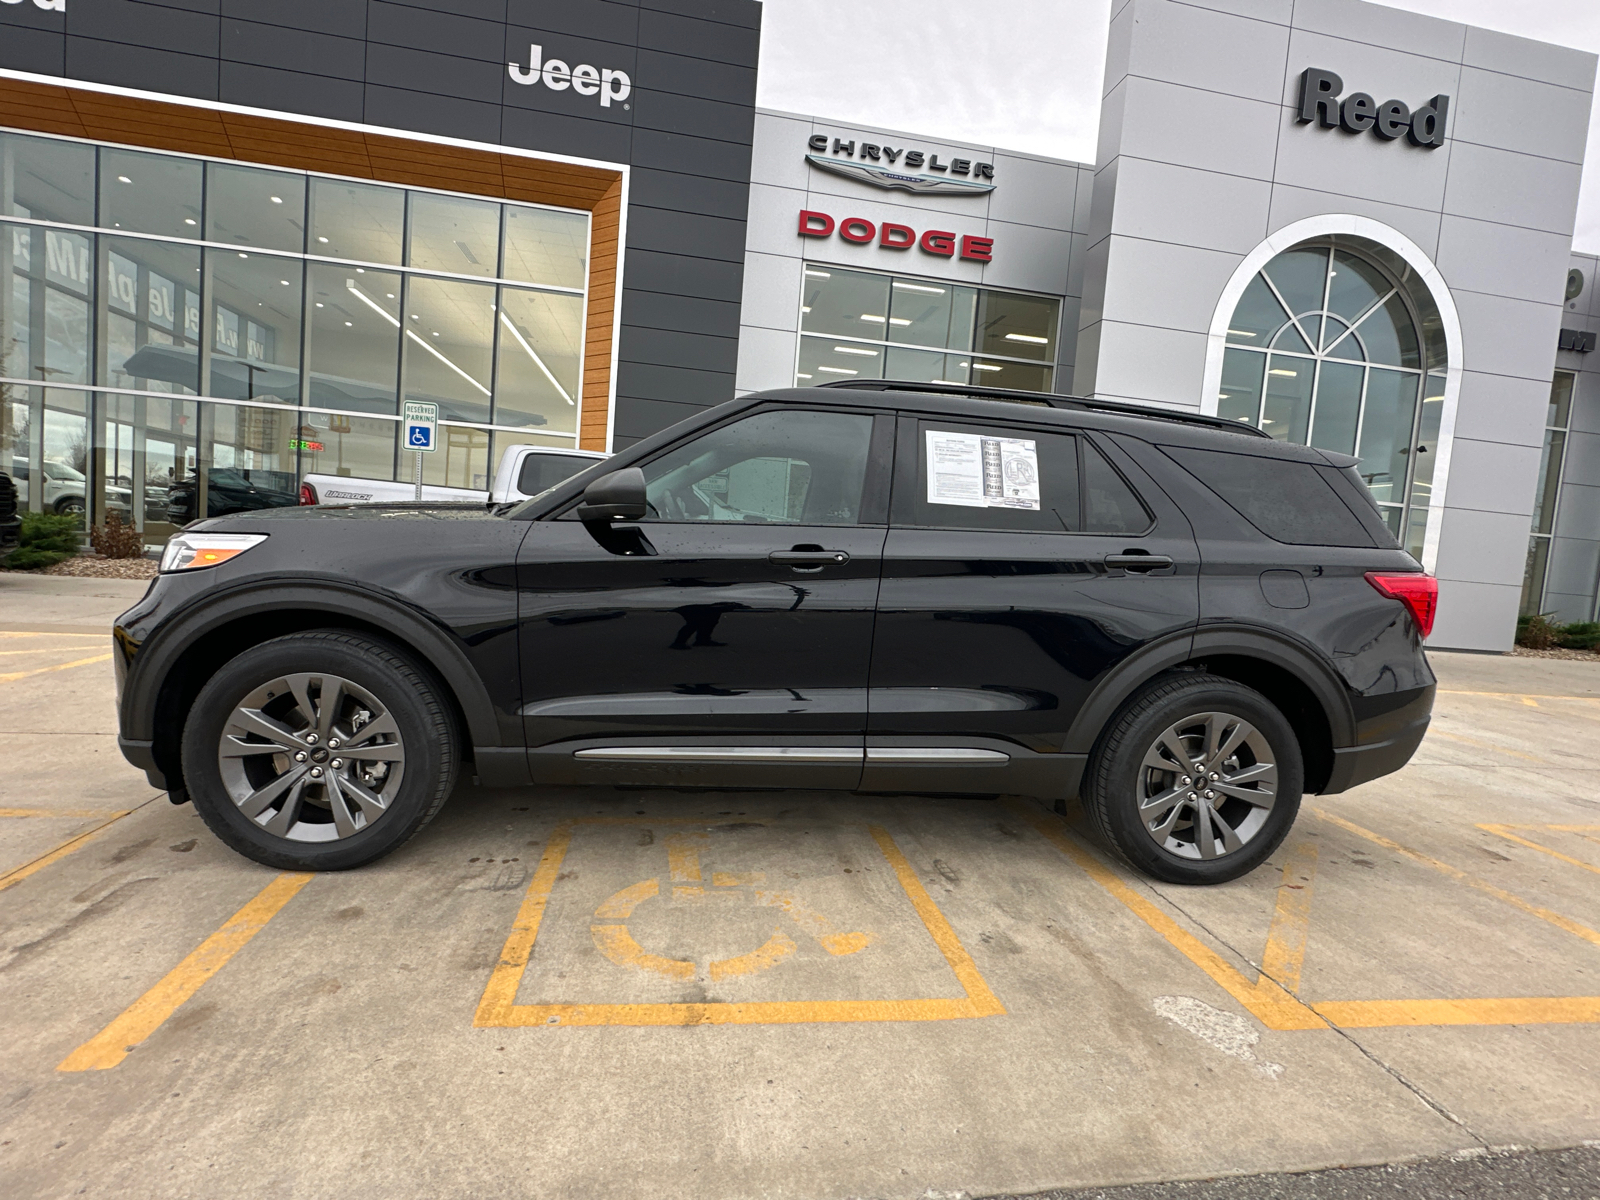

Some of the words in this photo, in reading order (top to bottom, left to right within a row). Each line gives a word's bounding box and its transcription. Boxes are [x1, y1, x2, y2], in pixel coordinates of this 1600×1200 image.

[508, 44, 631, 108] Jeep
[1298, 67, 1450, 150] Reed
[808, 134, 995, 178] CHRYSLER
[883, 173, 921, 183] CHRYSLER
[798, 209, 994, 263] DODGE
[406, 405, 434, 415] RESERVED
[406, 413, 434, 423] PARKING
[325, 490, 373, 500] WARLOCK
